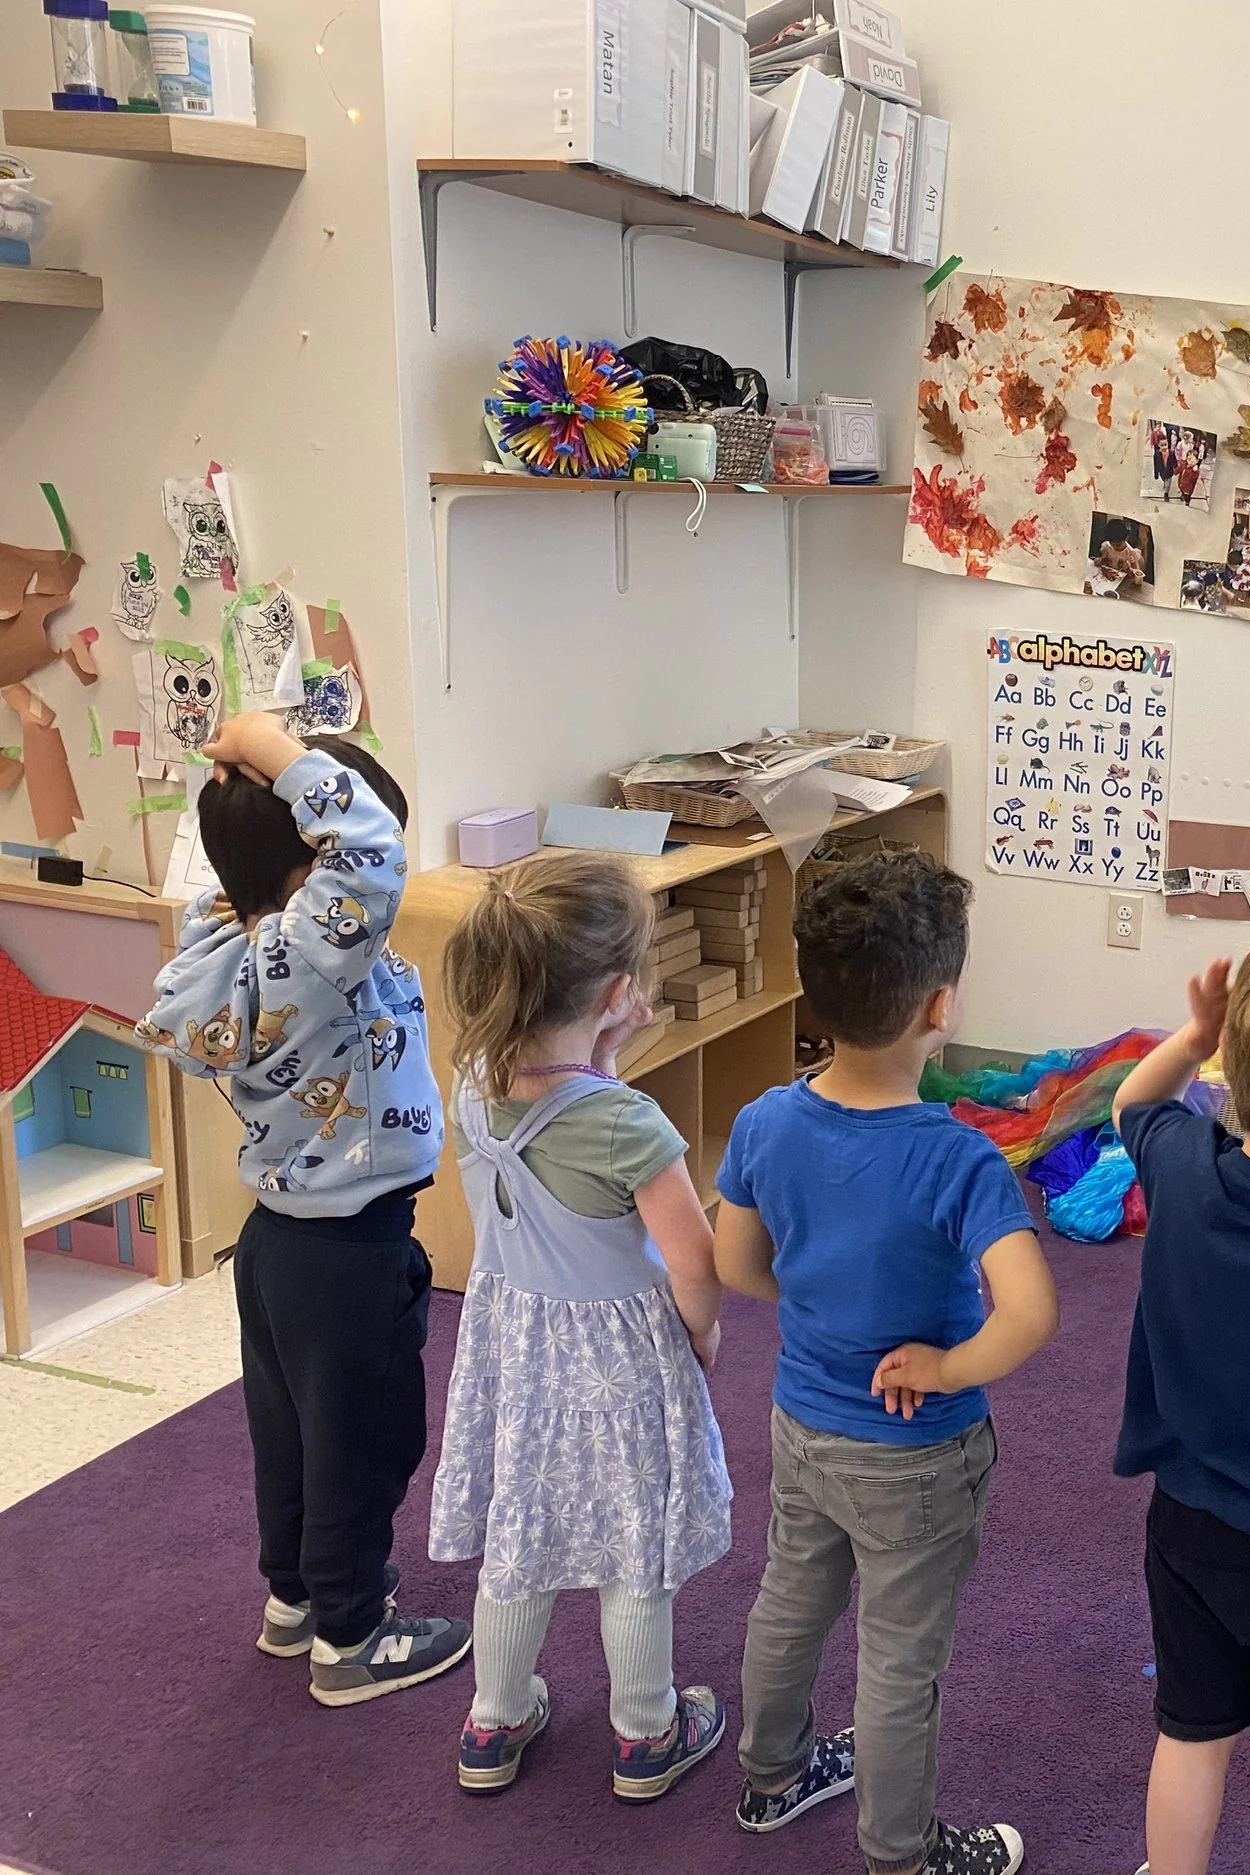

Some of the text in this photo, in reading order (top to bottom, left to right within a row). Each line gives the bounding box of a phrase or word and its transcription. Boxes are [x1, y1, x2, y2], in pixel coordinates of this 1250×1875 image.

[863, 16, 883, 39] Noah
[602, 30, 615, 95] Matan
[870, 157, 889, 210] Parker
[925, 184, 939, 212] Lily
[1017, 634, 1145, 671] alphabet
[994, 684, 1166, 718] Aa Bb Cc Dd Ee
[996, 726, 1165, 761] Ff Gg Hh Ii Jj Kk
[996, 767, 1163, 806] Ll Mm Nn Oo Pp
[993, 807, 1160, 842] Qq Rr Ss Tt Uu
[992, 846, 1159, 882] Vv Ww Xx Yy Zz
[381, 1104, 432, 1136] BLUEY
